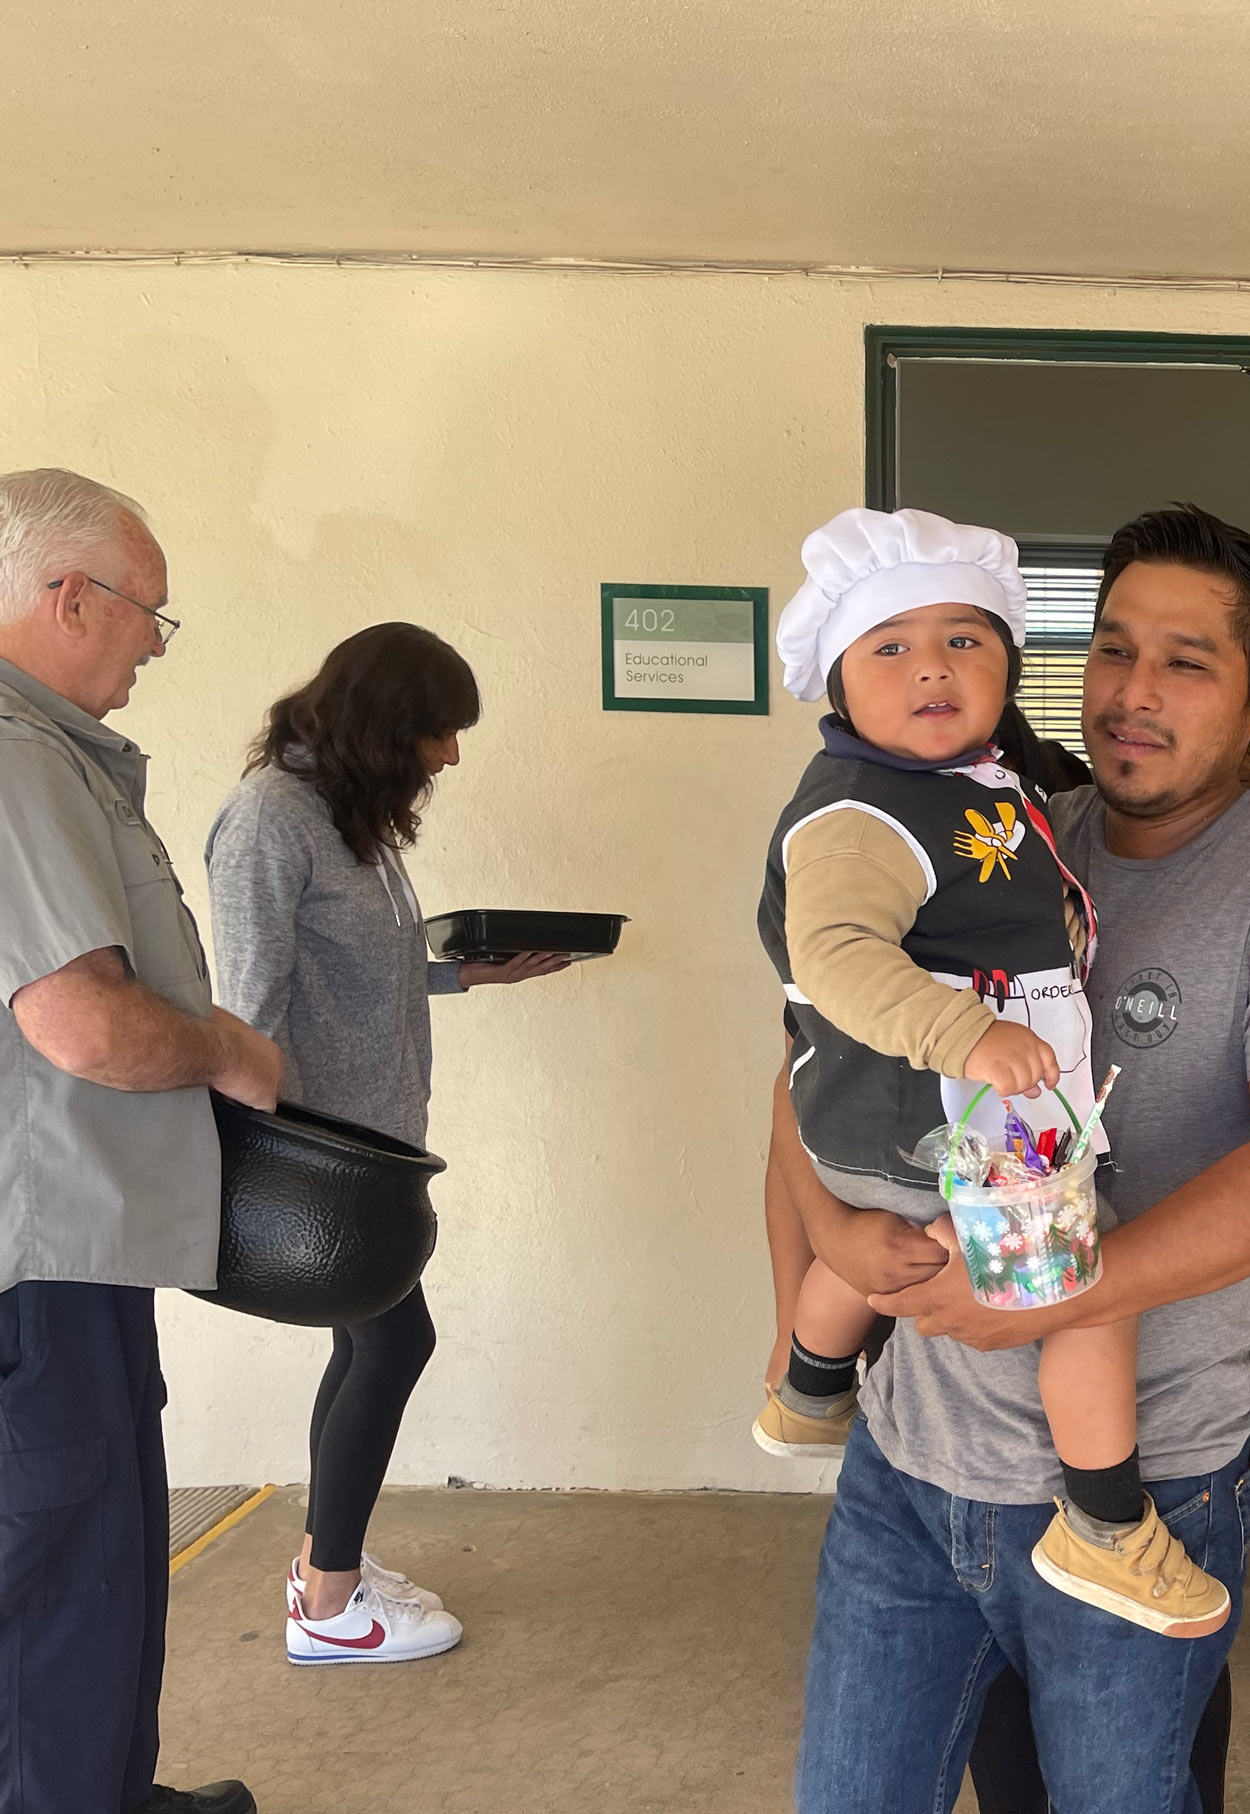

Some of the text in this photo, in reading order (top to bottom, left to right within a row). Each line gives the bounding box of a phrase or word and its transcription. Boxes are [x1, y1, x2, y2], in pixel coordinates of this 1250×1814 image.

[624, 608, 675, 632] 402
[625, 653, 708, 667] Educational
[626, 669, 684, 683] Services
[1031, 985, 1072, 1000] ORDE
